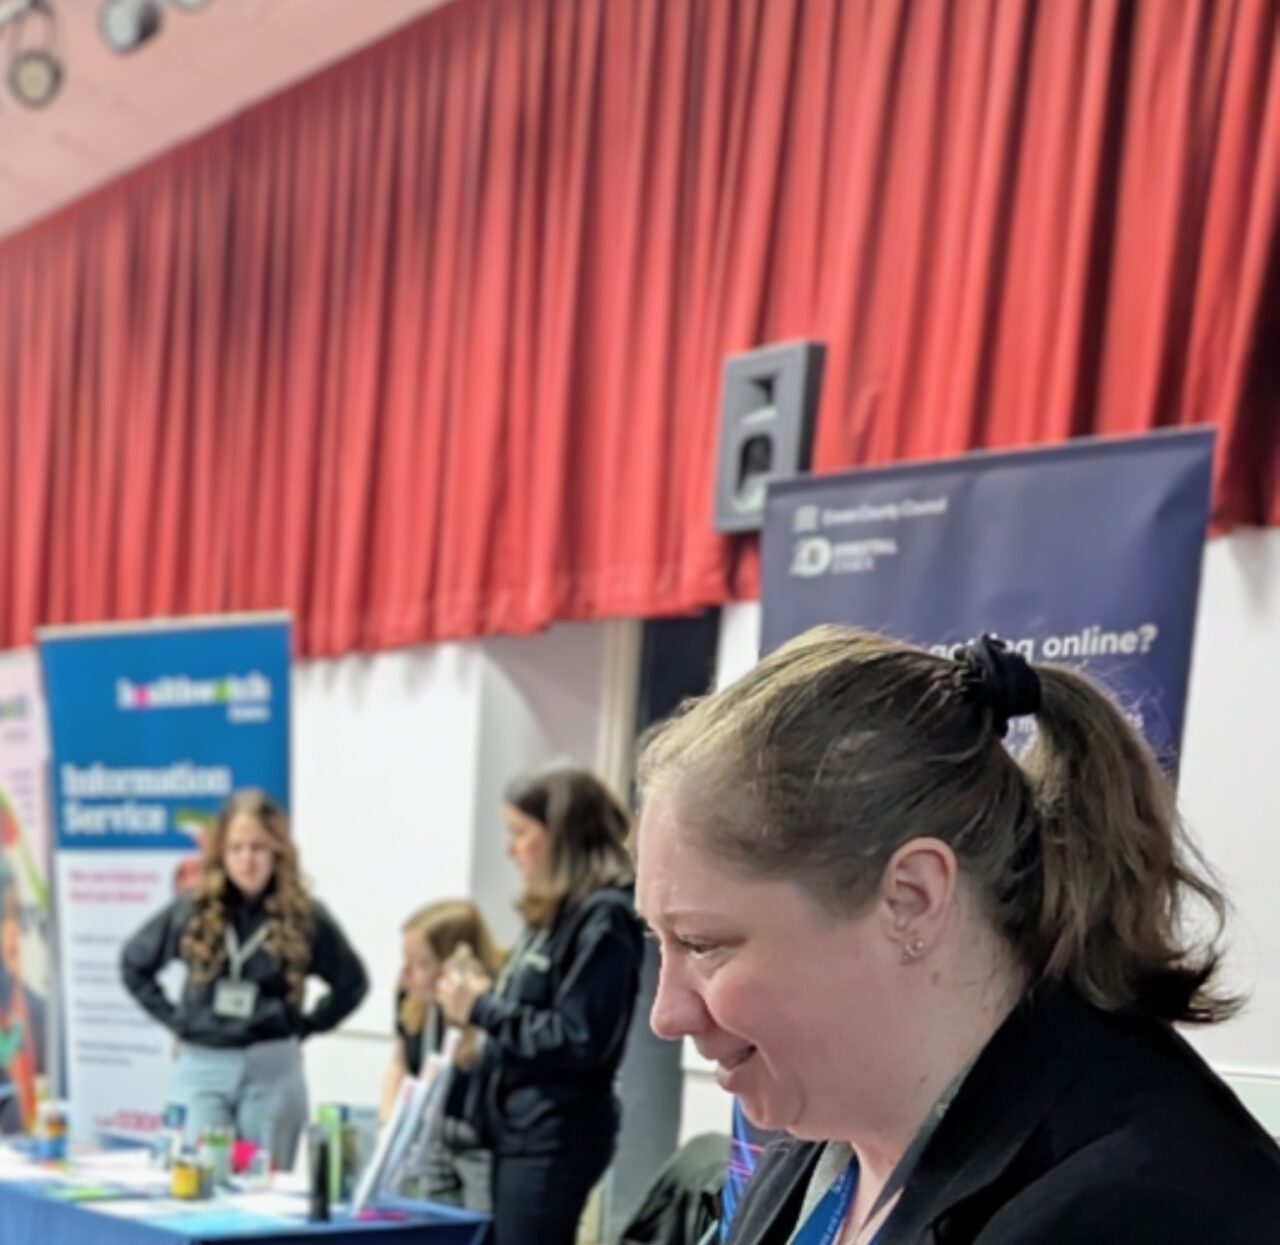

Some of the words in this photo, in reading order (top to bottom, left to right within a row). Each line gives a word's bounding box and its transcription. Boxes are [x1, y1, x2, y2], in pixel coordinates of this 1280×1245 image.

[1042, 624, 1158, 659] online?
[61, 760, 232, 797] Information
[63, 800, 166, 836] Service
